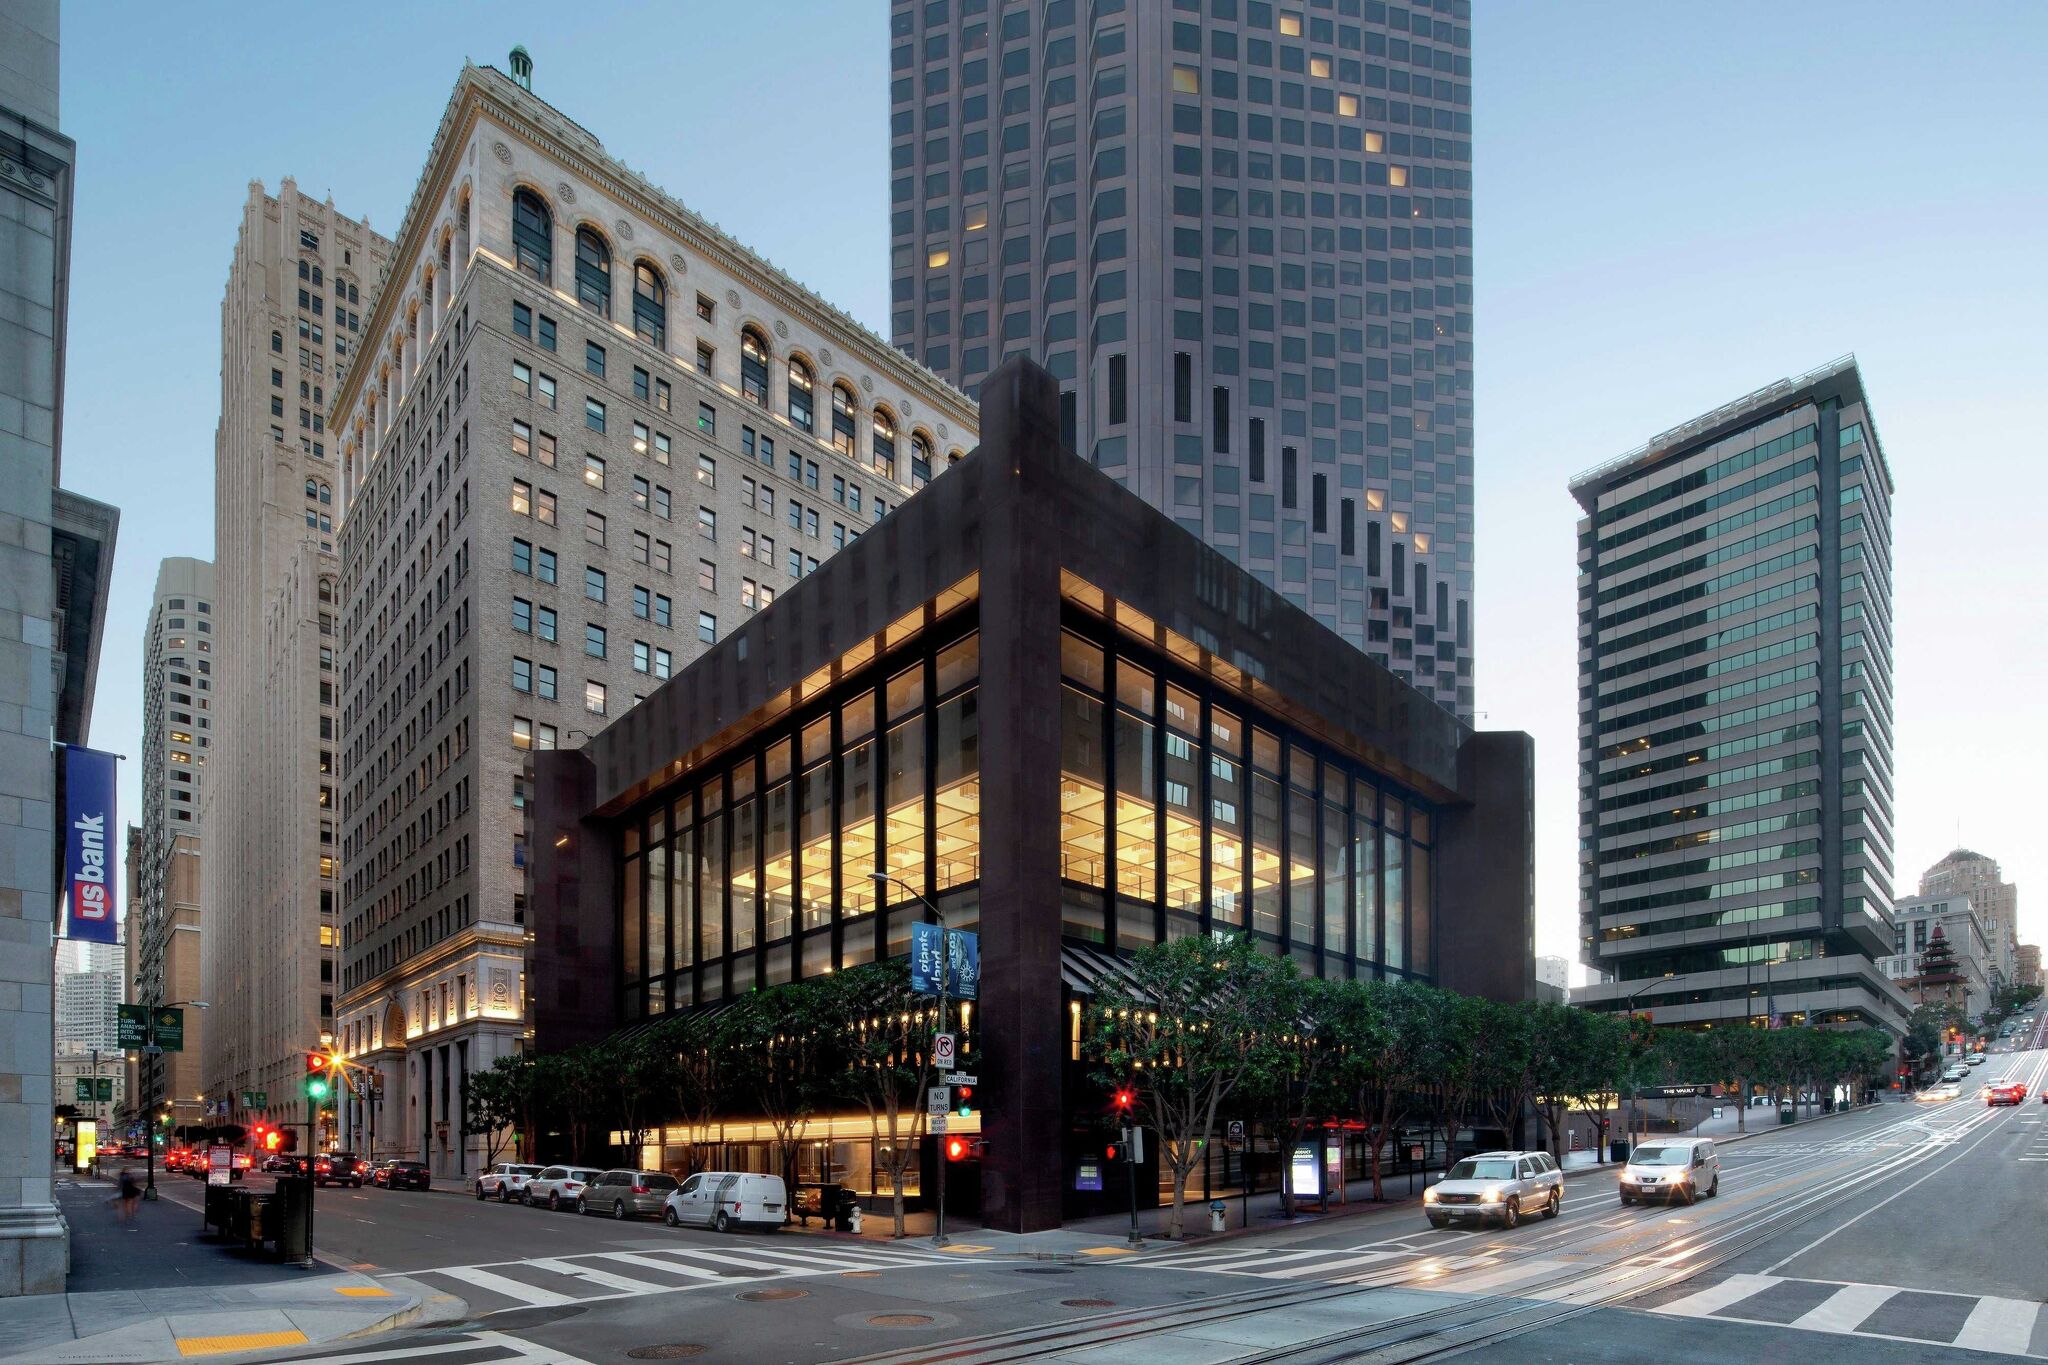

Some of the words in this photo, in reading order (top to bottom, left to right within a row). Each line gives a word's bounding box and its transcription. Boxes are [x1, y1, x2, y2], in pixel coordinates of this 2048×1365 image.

[930, 950, 941, 982] land
[946, 1075, 976, 1083] CALIFORNIA
[934, 1091, 944, 1100] NO
